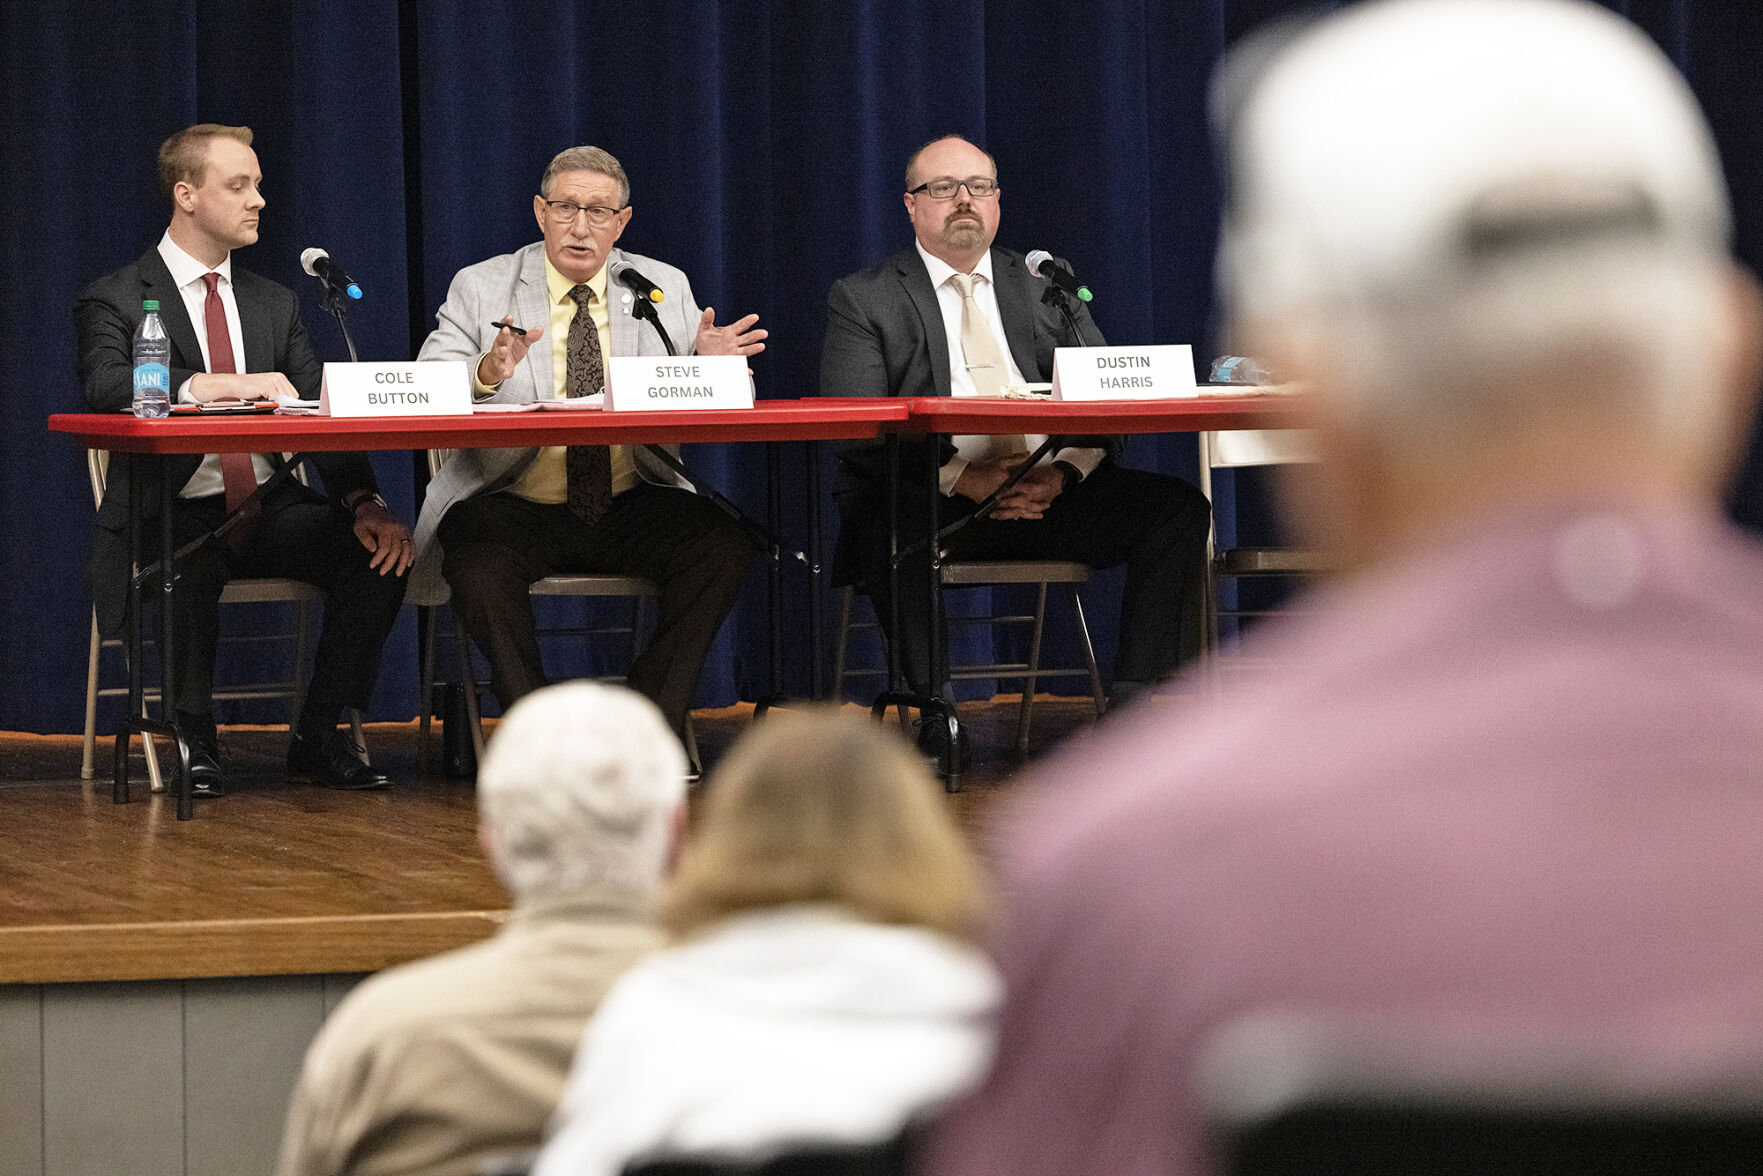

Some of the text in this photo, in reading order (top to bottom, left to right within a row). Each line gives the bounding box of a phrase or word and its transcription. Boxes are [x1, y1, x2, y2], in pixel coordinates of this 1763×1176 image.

[1097, 356, 1151, 369] DUSTIN
[374, 372, 414, 385] COLE
[655, 366, 700, 378] STEVE
[1101, 376, 1153, 389] HARRIS
[368, 392, 430, 405] BUTTON
[647, 386, 714, 399] GORMAN
